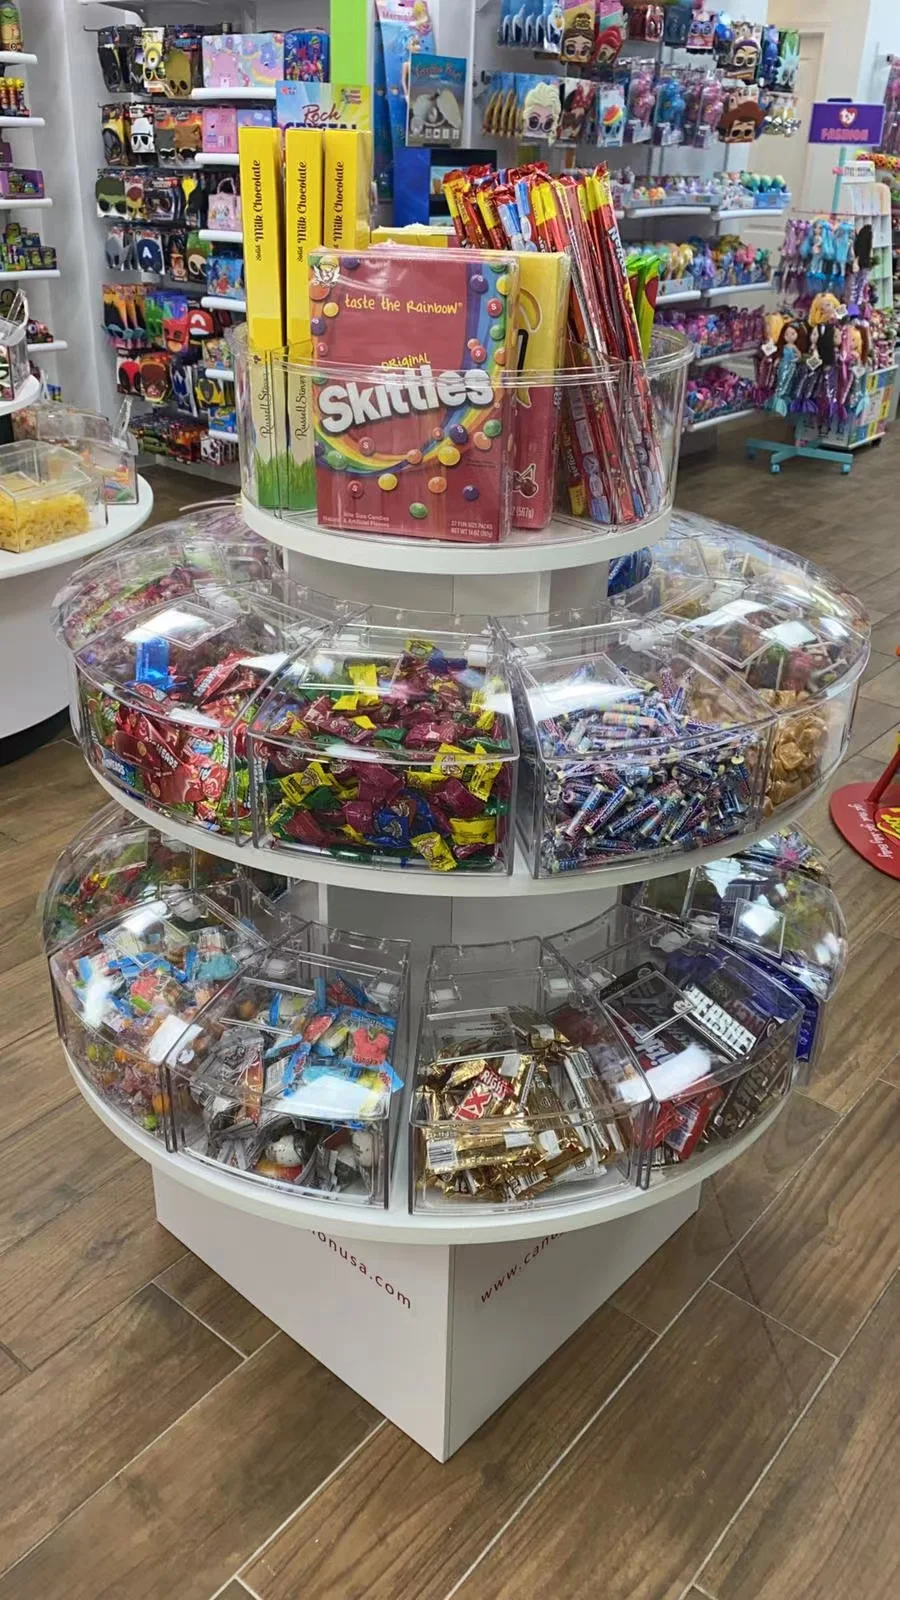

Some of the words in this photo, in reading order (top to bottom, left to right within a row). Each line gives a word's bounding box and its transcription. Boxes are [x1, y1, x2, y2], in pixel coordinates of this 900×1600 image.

[302, 103, 342, 126] Rock
[252, 160, 263, 213] Chocolate
[297, 161, 307, 214] Chocolate
[333, 161, 344, 213] Chocolate
[254, 214, 264, 242] Milk
[297, 216, 307, 243] Milk
[333, 214, 343, 241] Milk
[345, 294, 375, 310] taste
[381, 295, 400, 312] the
[406, 301, 458, 314] Rainbow
[319, 364, 494, 433] Skittles
[260, 403, 274, 438] Russell
[294, 406, 309, 440] Russell
[479, 1069, 508, 1100] RIGHT
[312, 1230, 411, 1309] onusa.com
